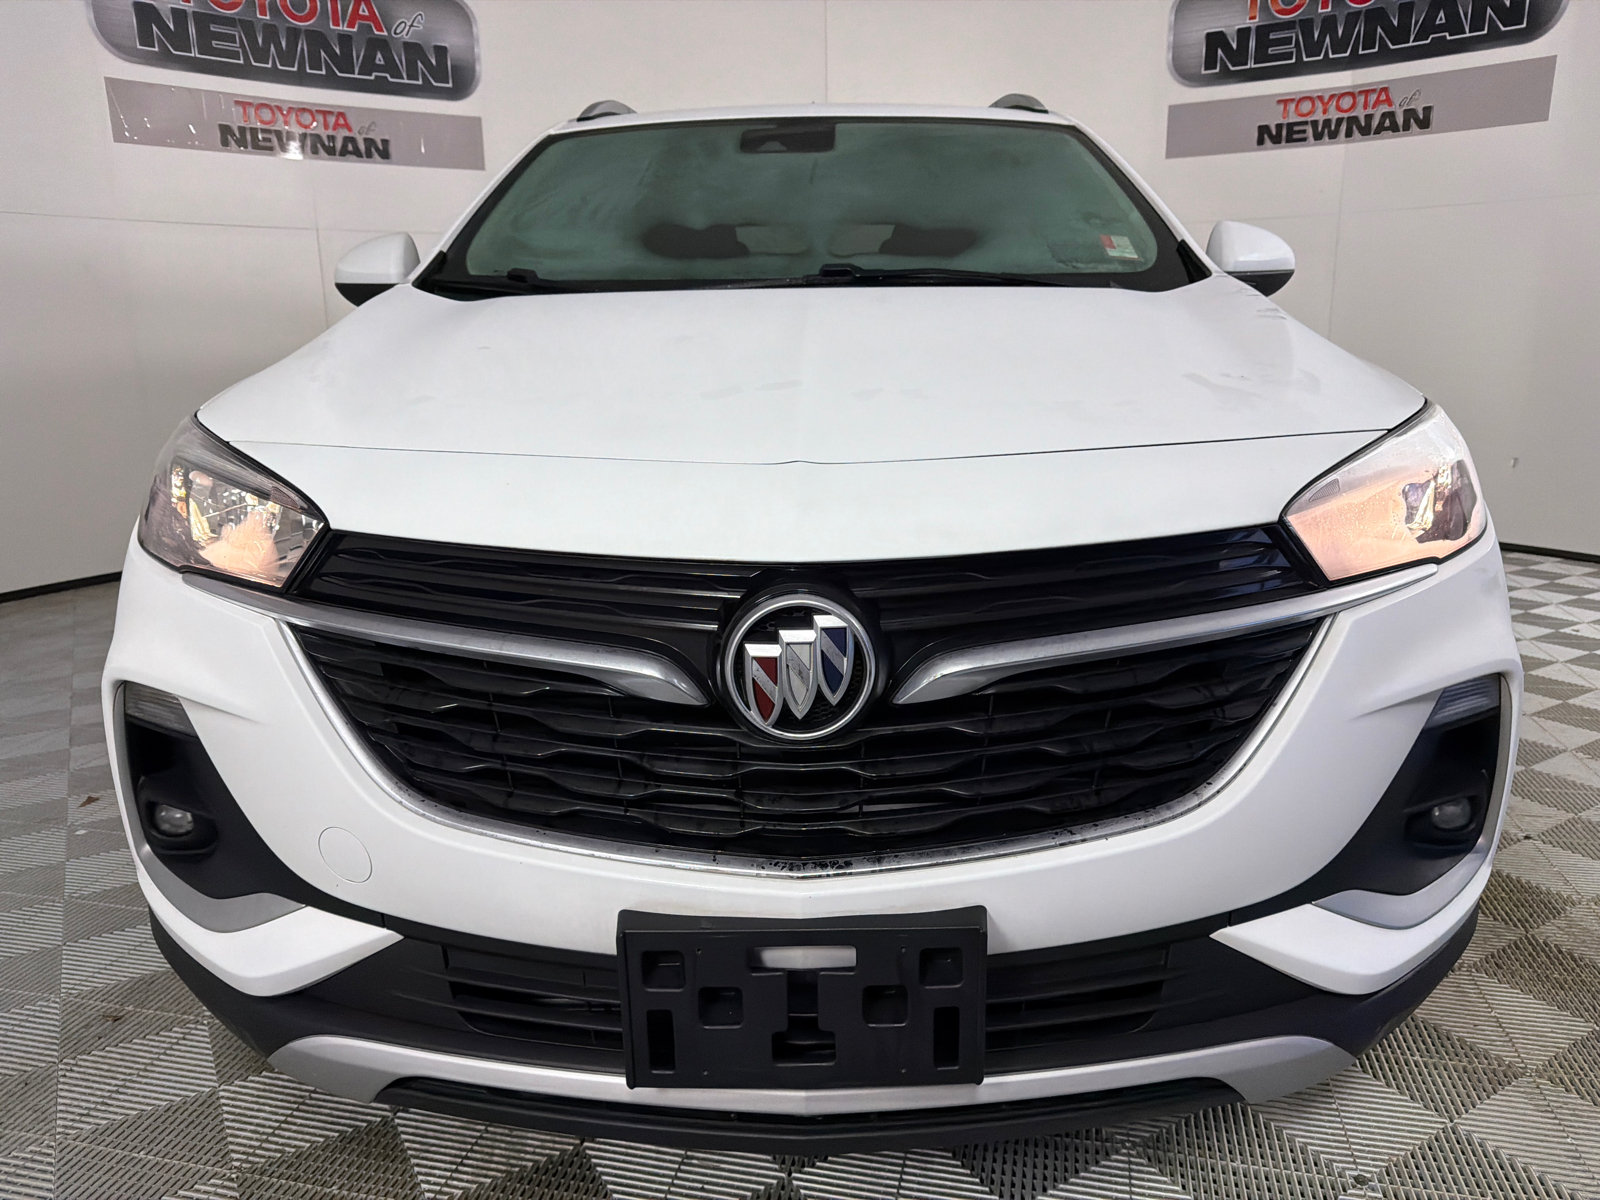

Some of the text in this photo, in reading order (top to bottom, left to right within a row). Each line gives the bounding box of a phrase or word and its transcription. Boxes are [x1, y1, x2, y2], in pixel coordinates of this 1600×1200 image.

[391, 12, 425, 38] of
[1201, 0, 1531, 75] NEWNAN
[131, 1, 454, 88] NEWNAN
[234, 100, 376, 136] TOYOTA of
[1276, 86, 1422, 119] TOYOTA of
[217, 123, 391, 160] NEWNAN
[1256, 105, 1433, 146] NEWNAN
